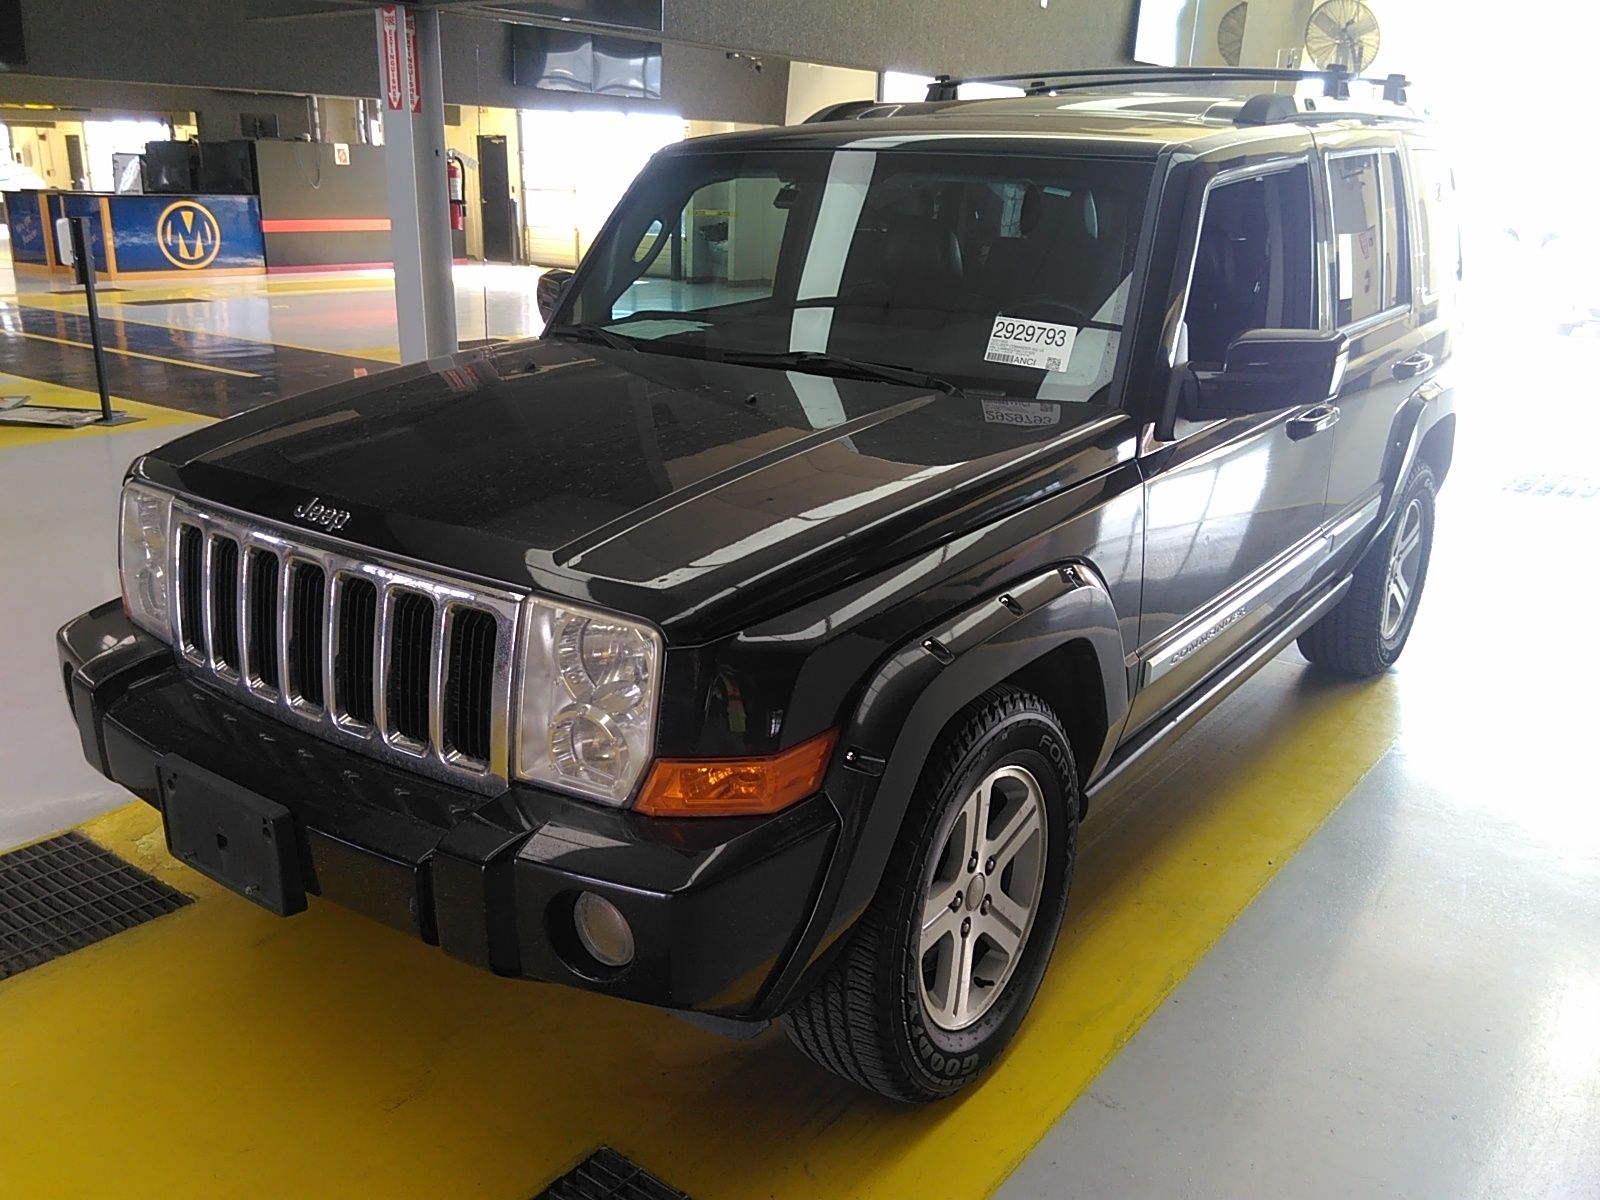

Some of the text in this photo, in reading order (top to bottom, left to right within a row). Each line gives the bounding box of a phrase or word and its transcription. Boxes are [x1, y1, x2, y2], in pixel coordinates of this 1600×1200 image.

[388, 29, 397, 102] EXTINGUISHER
[992, 321, 1067, 347] 2929793
[1013, 356, 1037, 366] ANCI
[293, 497, 350, 532] Jeep
[1169, 605, 1247, 665] COMMANDER
